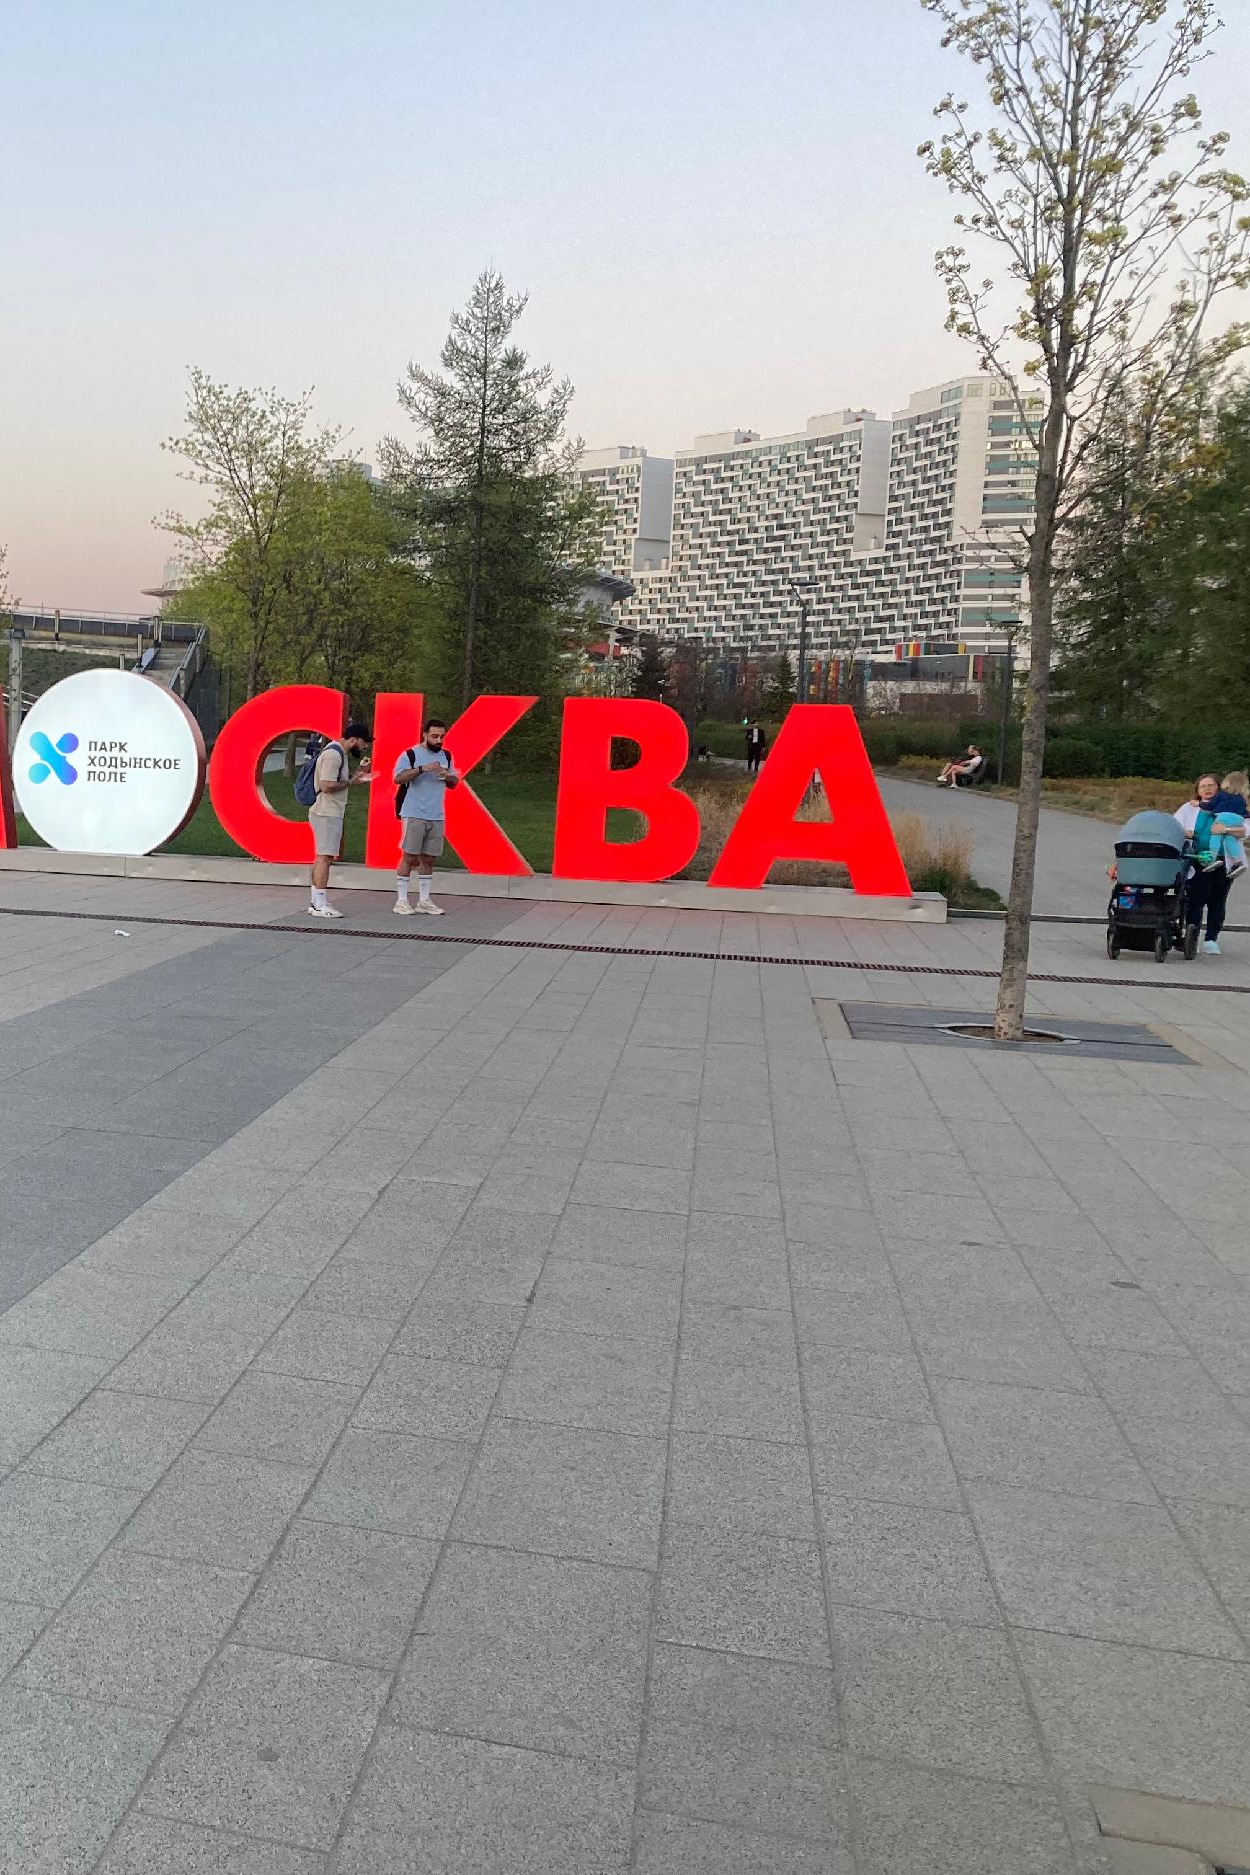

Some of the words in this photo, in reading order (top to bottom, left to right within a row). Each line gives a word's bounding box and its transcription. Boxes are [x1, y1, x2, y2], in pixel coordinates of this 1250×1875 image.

[88, 740, 128, 753] ПАРК
[87, 755, 181, 770] ХОДЫНСКОЕ
[87, 770, 127, 783] ПОЛЕ
